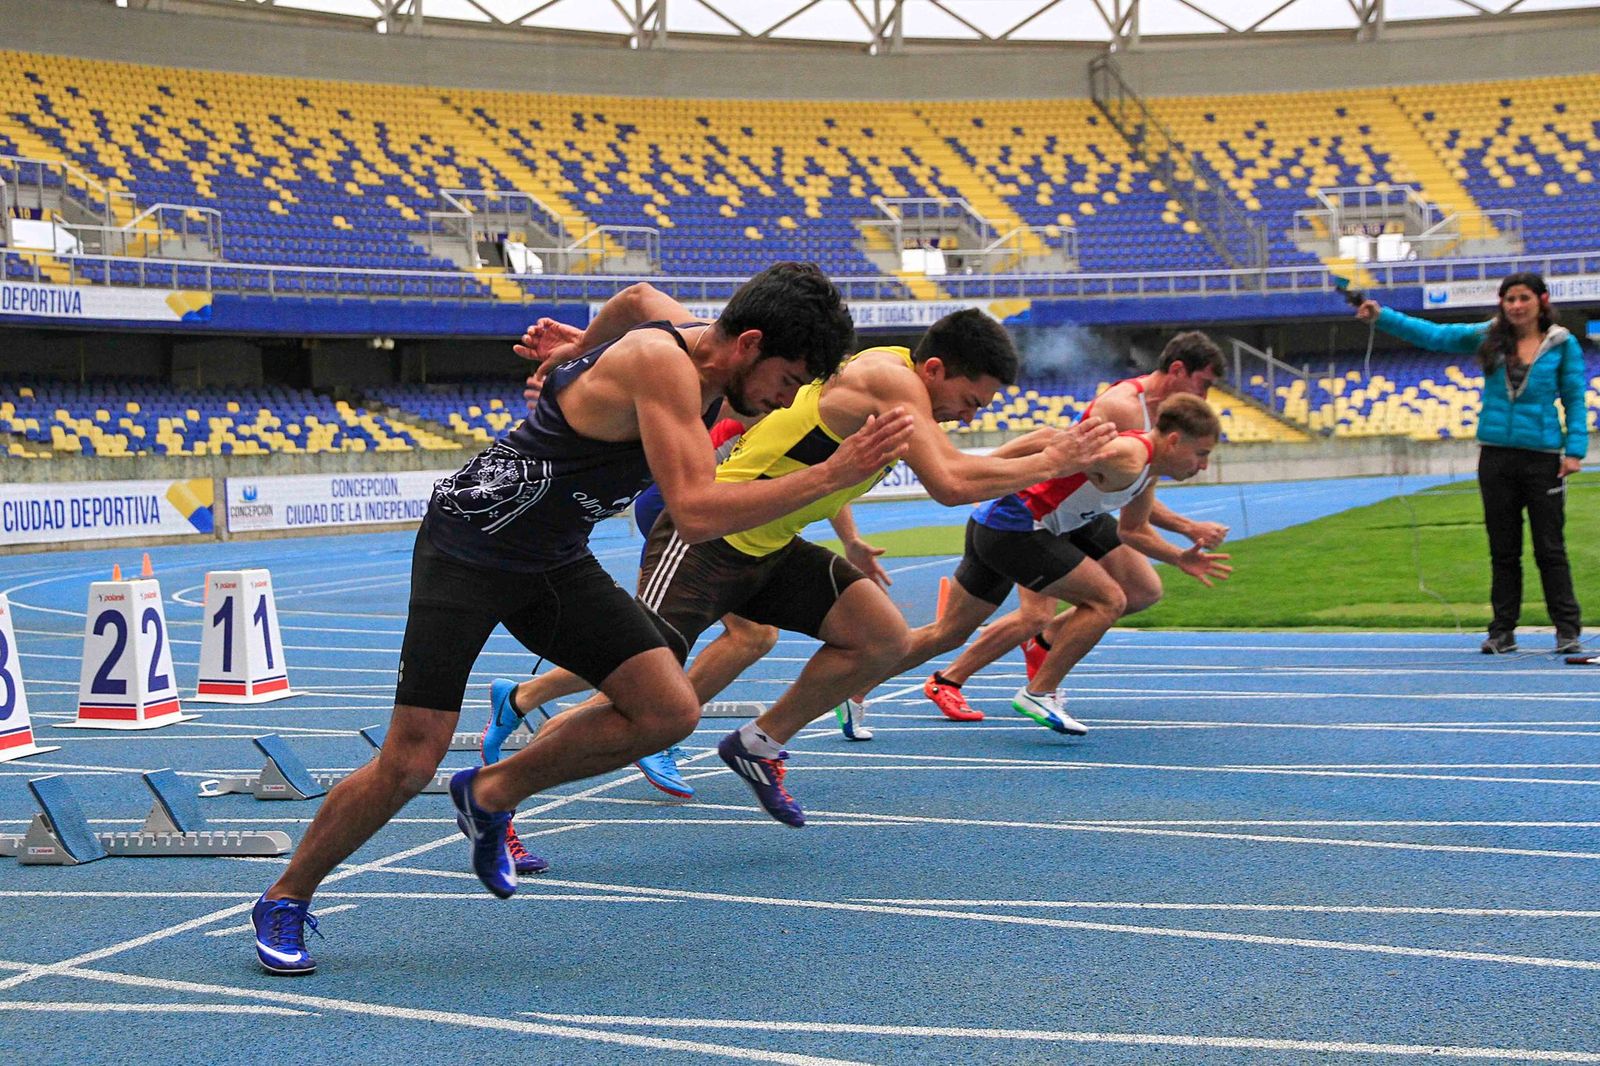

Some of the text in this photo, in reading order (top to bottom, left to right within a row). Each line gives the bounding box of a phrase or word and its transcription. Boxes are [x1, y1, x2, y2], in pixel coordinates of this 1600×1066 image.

[2, 286, 82, 314] DEPORTIVA
[3, 495, 161, 532] CIUDAD DEPORTIVA
[286, 504, 328, 525] CIUDAD
[331, 503, 345, 522] DE
[348, 501, 362, 521] LA
[365, 499, 429, 519] INDEPENDE
[91, 609, 128, 695] 2
[141, 607, 169, 693] 2
[213, 596, 233, 673] 1
[254, 594, 274, 670] 1
